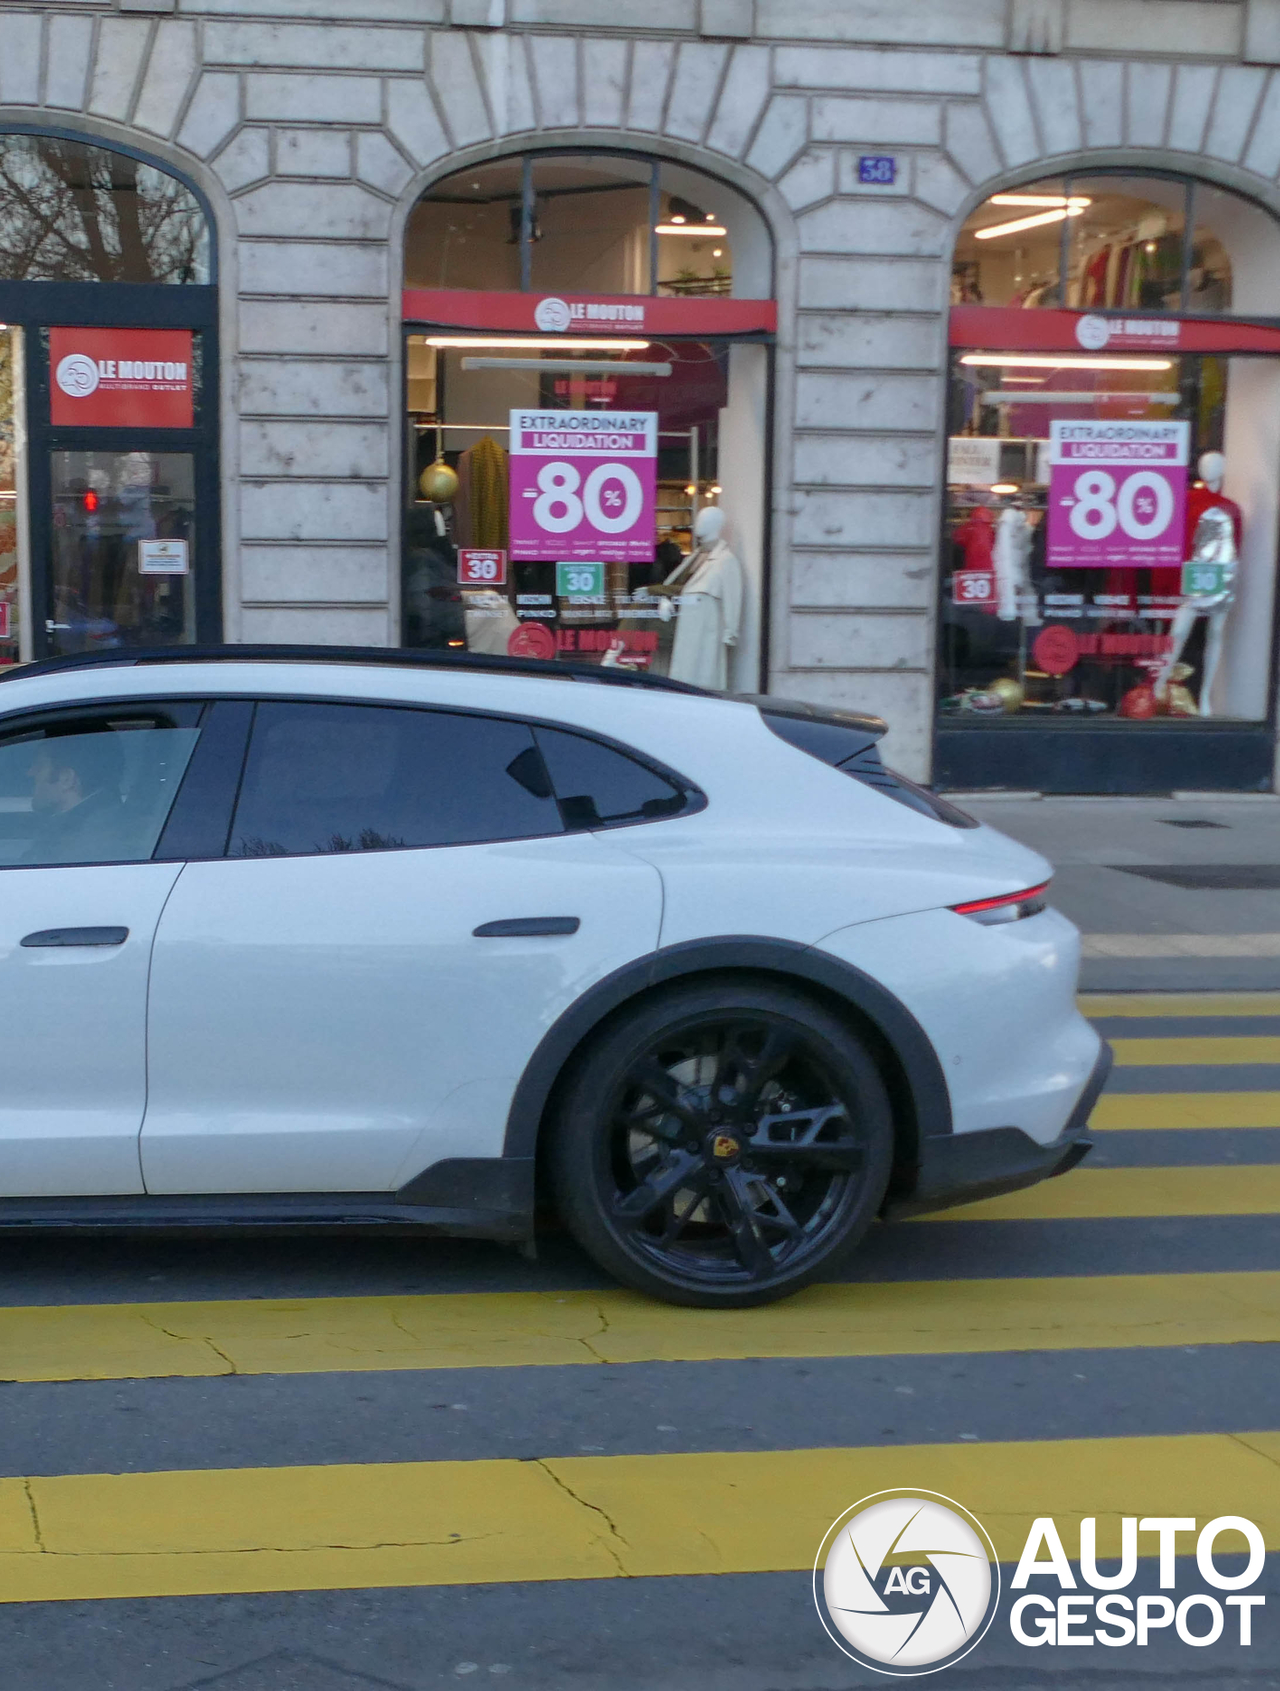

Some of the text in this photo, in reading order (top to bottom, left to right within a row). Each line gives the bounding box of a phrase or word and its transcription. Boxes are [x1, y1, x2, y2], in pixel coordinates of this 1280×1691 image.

[570, 303, 644, 321] LE MOUTON
[98, 360, 187, 381] LE MOUTON
[520, 416, 648, 431] EXTRAORDINARY
[532, 433, 634, 449] LIQUIDATION
[1060, 427, 1179, 441] EXTRAORDINARY
[1071, 443, 1168, 458] LIQUIDATION
[467, 560, 498, 579] 30
[566, 572, 594, 591] 30
[962, 580, 990, 598] 30
